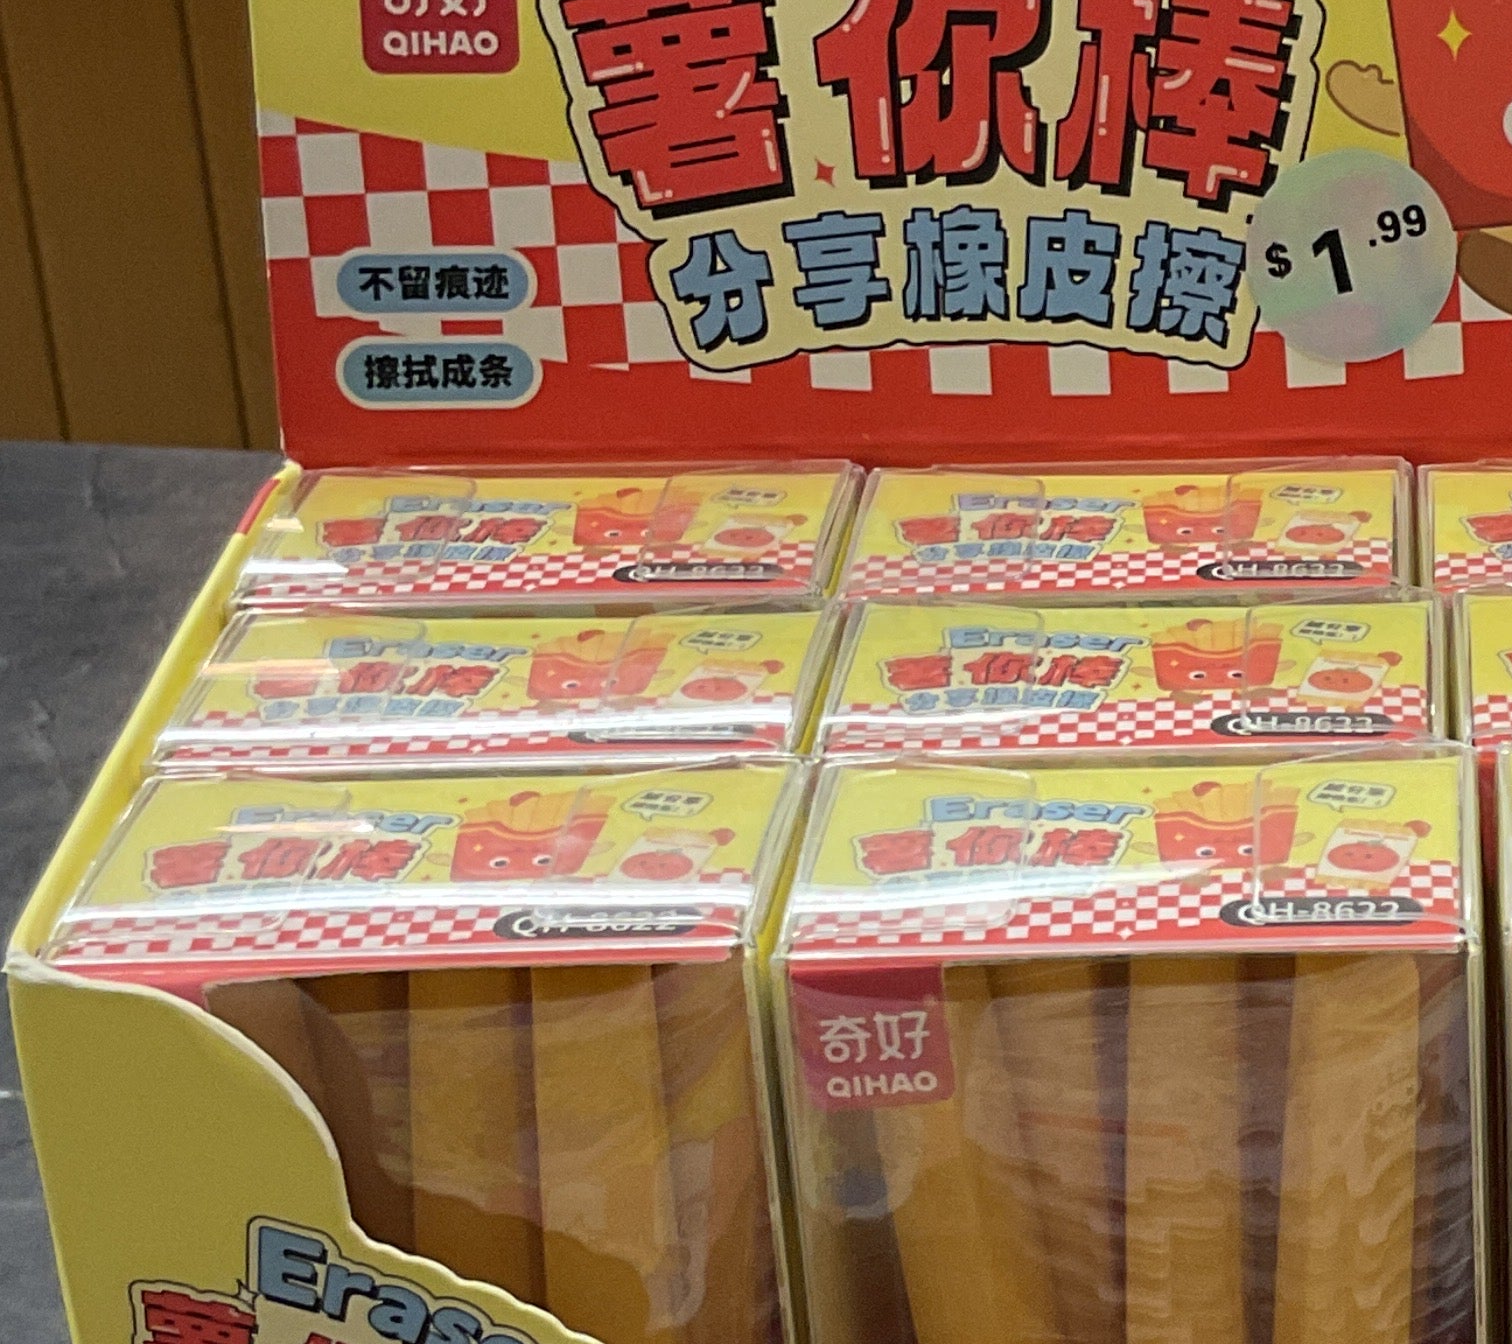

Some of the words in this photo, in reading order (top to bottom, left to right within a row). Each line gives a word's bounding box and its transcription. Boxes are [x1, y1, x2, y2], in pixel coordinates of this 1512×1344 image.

[383, 31, 499, 56] QIHAO
[358, 265, 510, 303] 不留痕迹
[670, 204, 1248, 351] 分享橡皮擦
[364, 354, 514, 389] 擦拭成条
[931, 797, 1146, 824] Eraser
[820, 1011, 930, 1063] 奇好
[827, 1071, 937, 1098] QIHAO
